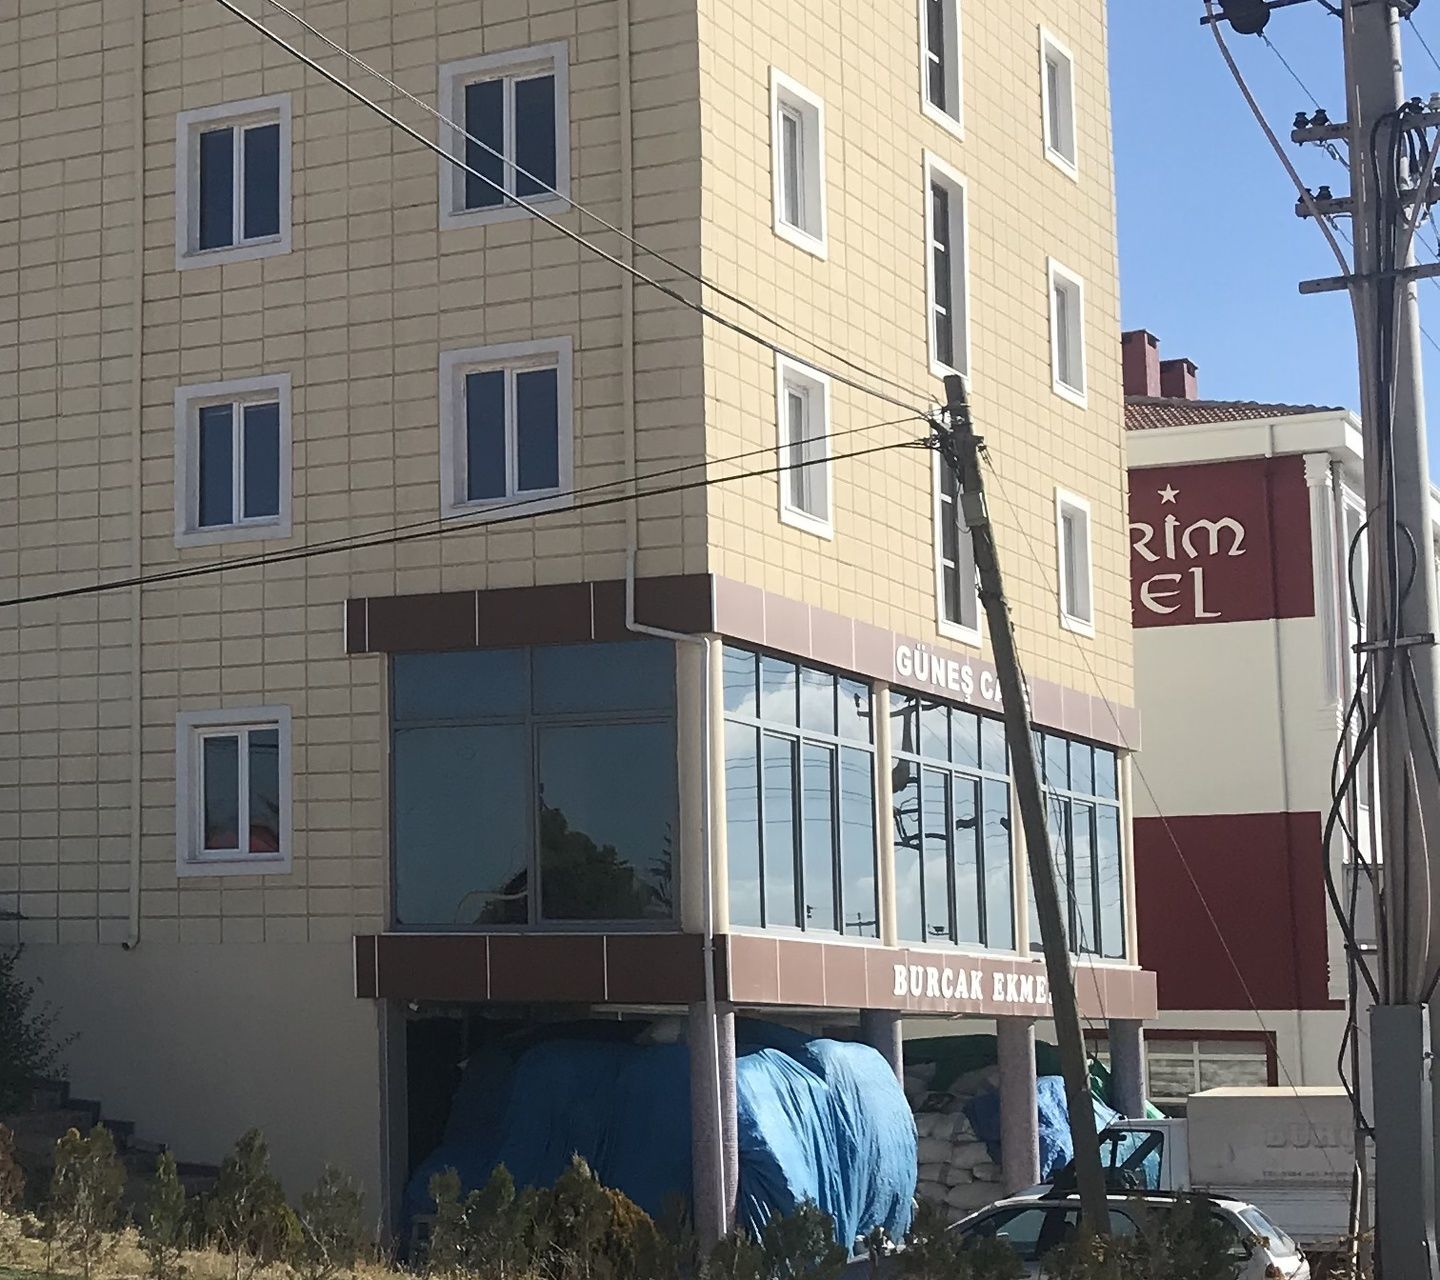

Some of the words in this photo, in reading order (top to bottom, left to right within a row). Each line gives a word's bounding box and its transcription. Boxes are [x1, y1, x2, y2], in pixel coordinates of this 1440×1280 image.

[1130, 566, 1222, 618] EL
[895, 643, 975, 705] GÜNEŞ
[893, 964, 984, 1001] BURCAK
[992, 972, 1053, 1005] EKME
